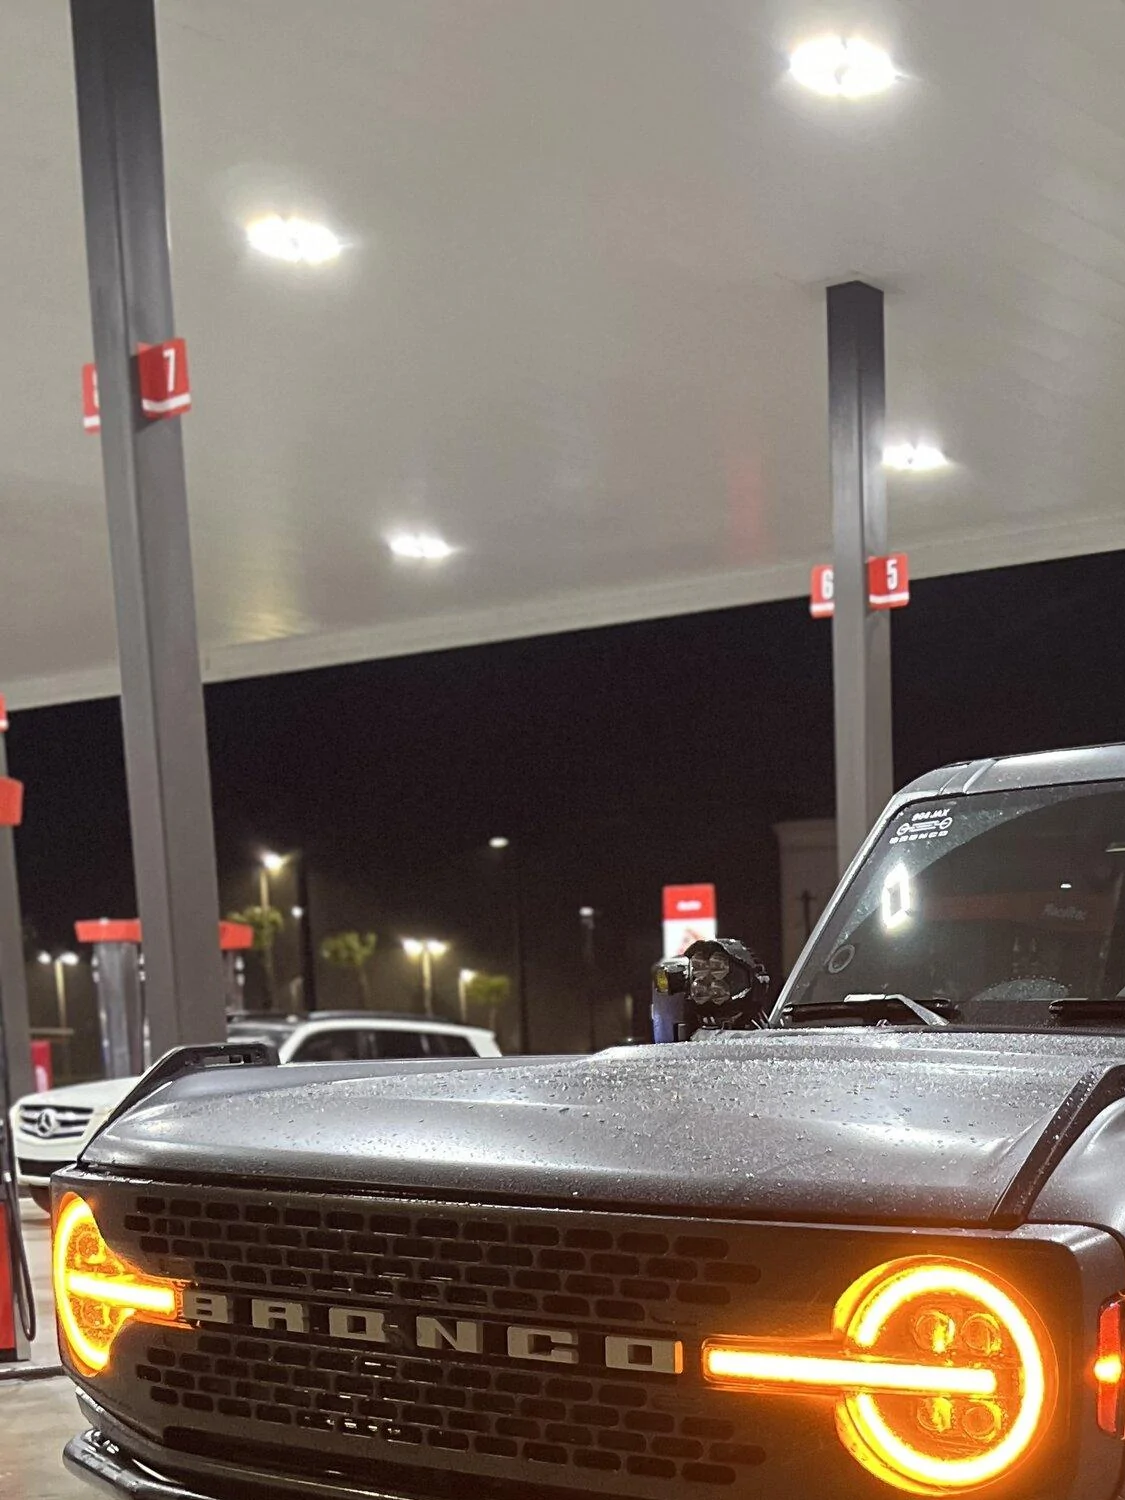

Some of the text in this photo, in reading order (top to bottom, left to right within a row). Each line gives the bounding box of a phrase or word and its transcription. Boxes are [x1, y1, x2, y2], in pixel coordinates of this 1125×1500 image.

[162, 347, 176, 393] 7
[821, 568, 834, 600] 6
[886, 558, 898, 591] 5
[182, 1292, 684, 1375] BRONCO
